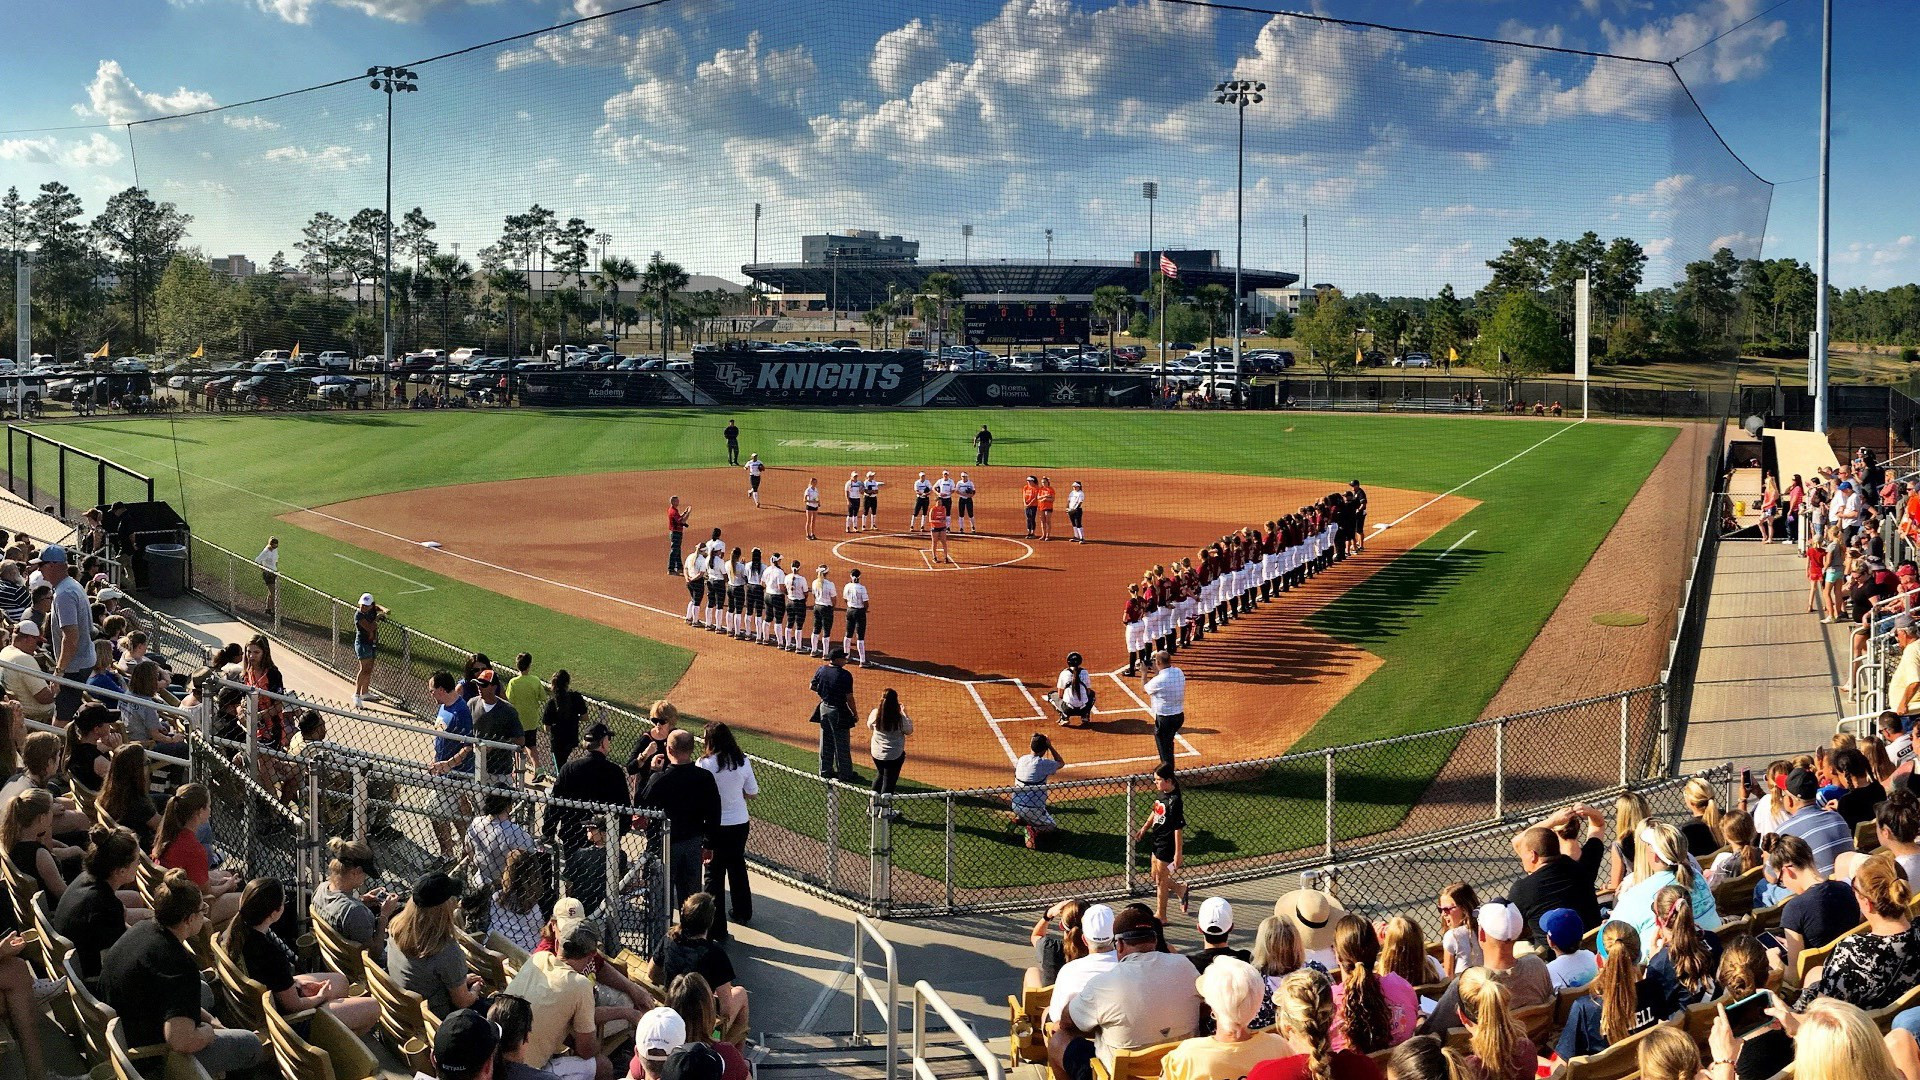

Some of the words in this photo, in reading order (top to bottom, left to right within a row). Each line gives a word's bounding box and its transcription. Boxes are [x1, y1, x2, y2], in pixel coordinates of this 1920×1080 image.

[713, 362, 754, 395] UCF
[756, 362, 904, 390] KNIGHTS
[588, 388, 625, 398] Academy
[765, 390, 887, 398] SOFTBALL
